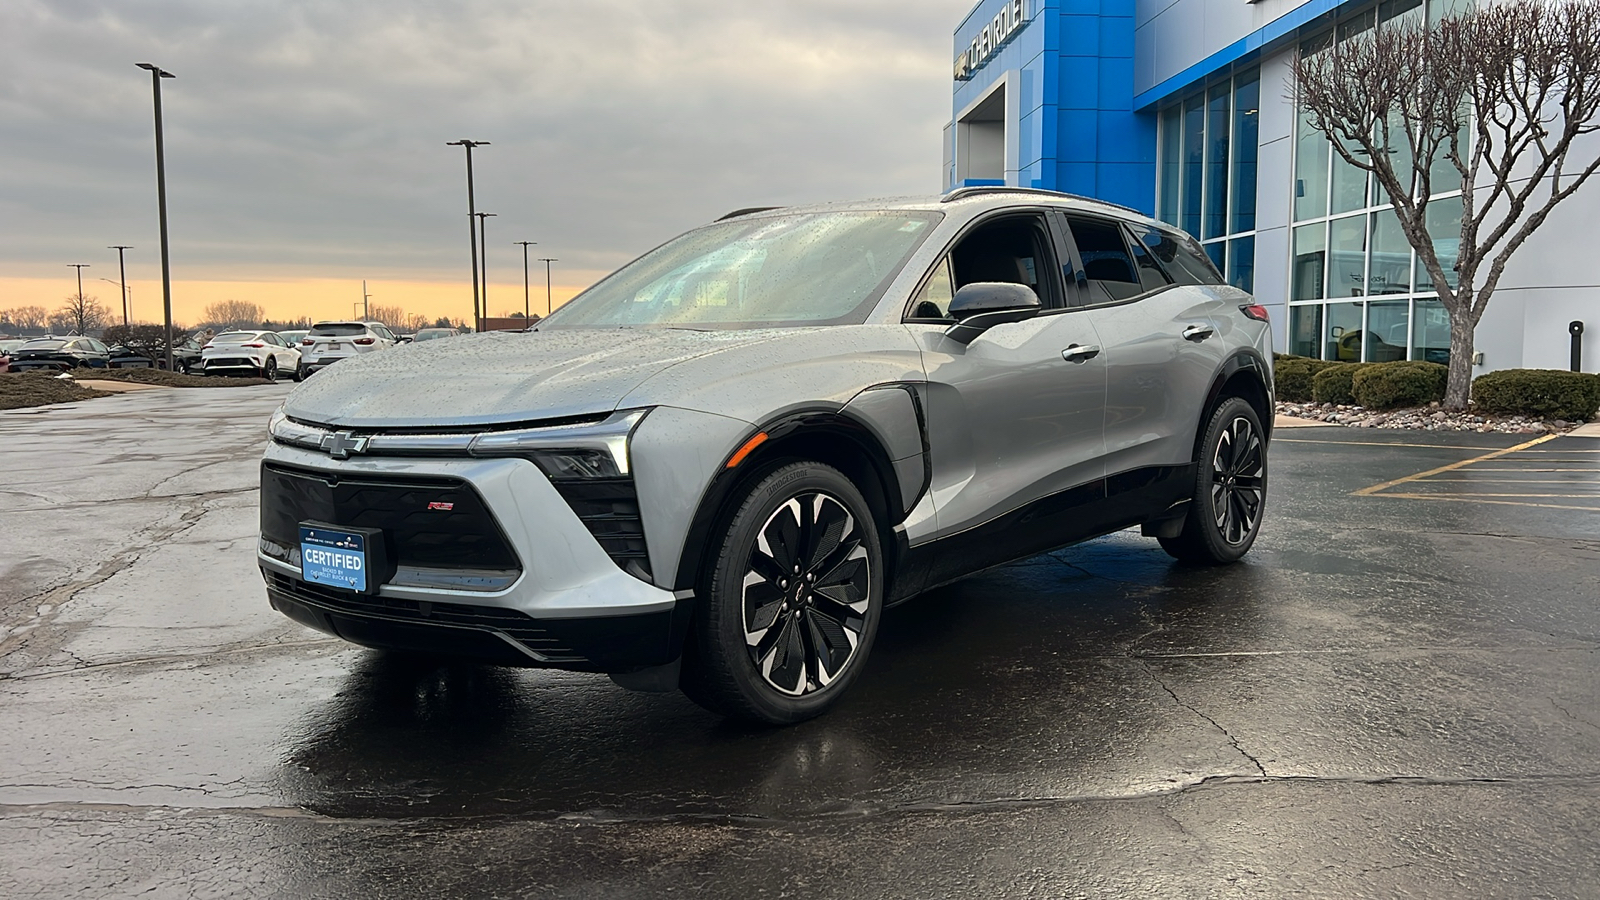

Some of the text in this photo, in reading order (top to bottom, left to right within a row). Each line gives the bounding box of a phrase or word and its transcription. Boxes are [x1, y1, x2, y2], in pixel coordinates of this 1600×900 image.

[970, 0, 1030, 71] CHEVROLET
[766, 469, 808, 497] BRIDGESTONE
[427, 501, 454, 511] RS
[305, 548, 362, 570] CERTIFIED
